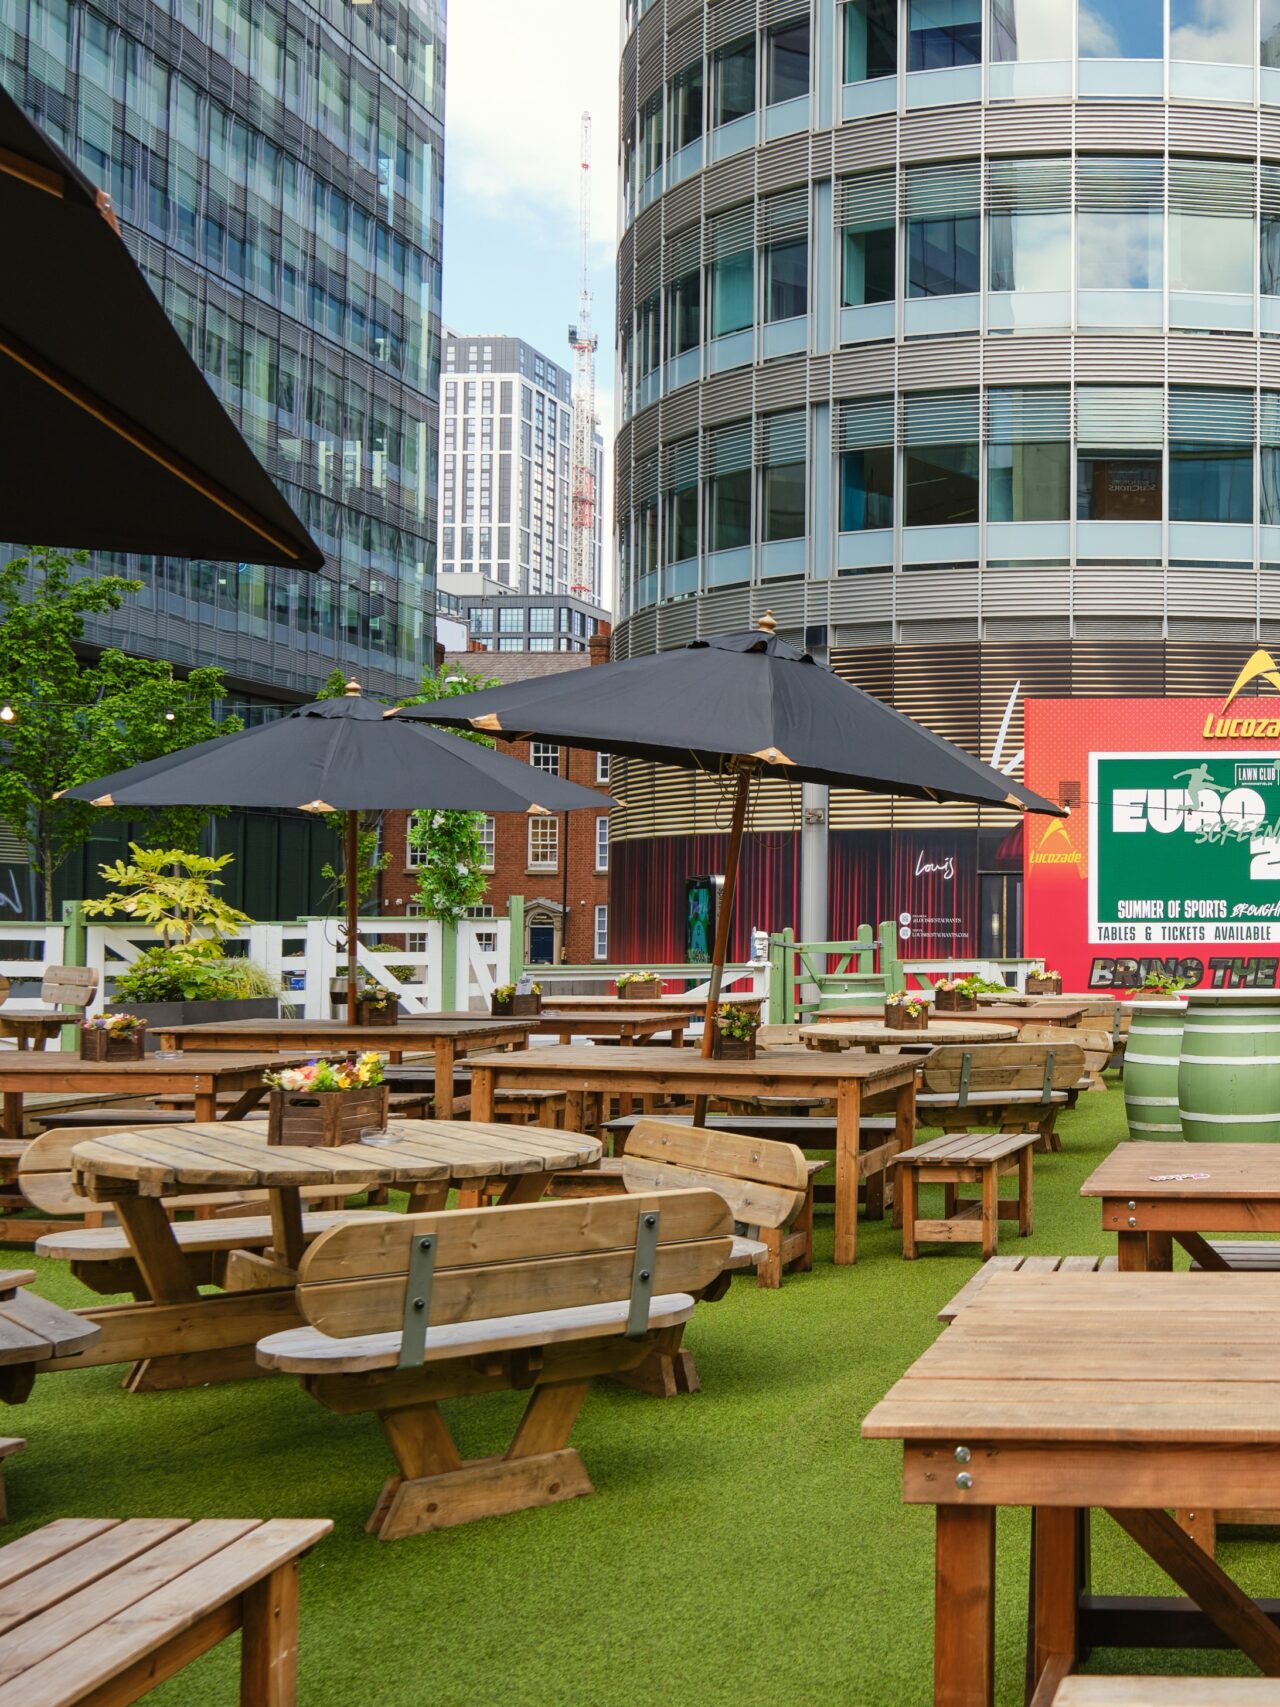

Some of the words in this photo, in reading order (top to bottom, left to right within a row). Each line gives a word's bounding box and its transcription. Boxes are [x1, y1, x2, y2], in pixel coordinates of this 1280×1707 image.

[1238, 767, 1258, 781] LAWN
[1259, 767, 1276, 781] CLUB
[1112, 787, 1266, 833] EURO
[915, 849, 954, 880] Louis
[1028, 850, 1082, 864] Lucozade
[1117, 900, 1164, 919] SUMMER
[1167, 900, 1181, 919] OF
[1184, 900, 1227, 919] SPORTS
[1097, 926, 1136, 941] TABLES
[1145, 926, 1152, 941] &
[1161, 926, 1205, 941] TICKETS
[1214, 926, 1271, 941] AVAILABLE
[1088, 957, 1204, 989] BRING
[1208, 957, 1280, 989] THE
